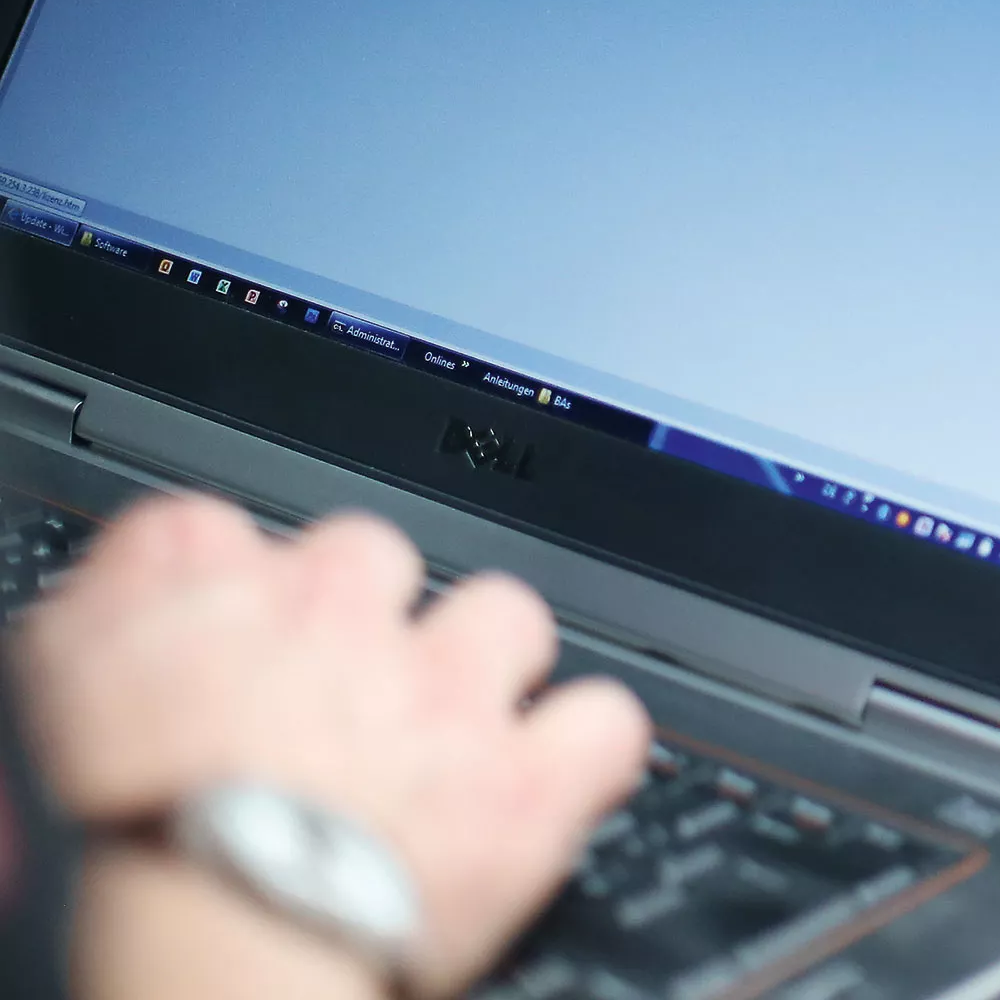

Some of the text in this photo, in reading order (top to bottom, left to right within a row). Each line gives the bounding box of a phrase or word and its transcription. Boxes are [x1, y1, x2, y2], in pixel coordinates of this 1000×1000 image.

[21, 211, 48, 230] Update
[94, 238, 128, 257] Software
[424, 351, 456, 370] Onlines
[483, 371, 535, 398] Anleitungen
